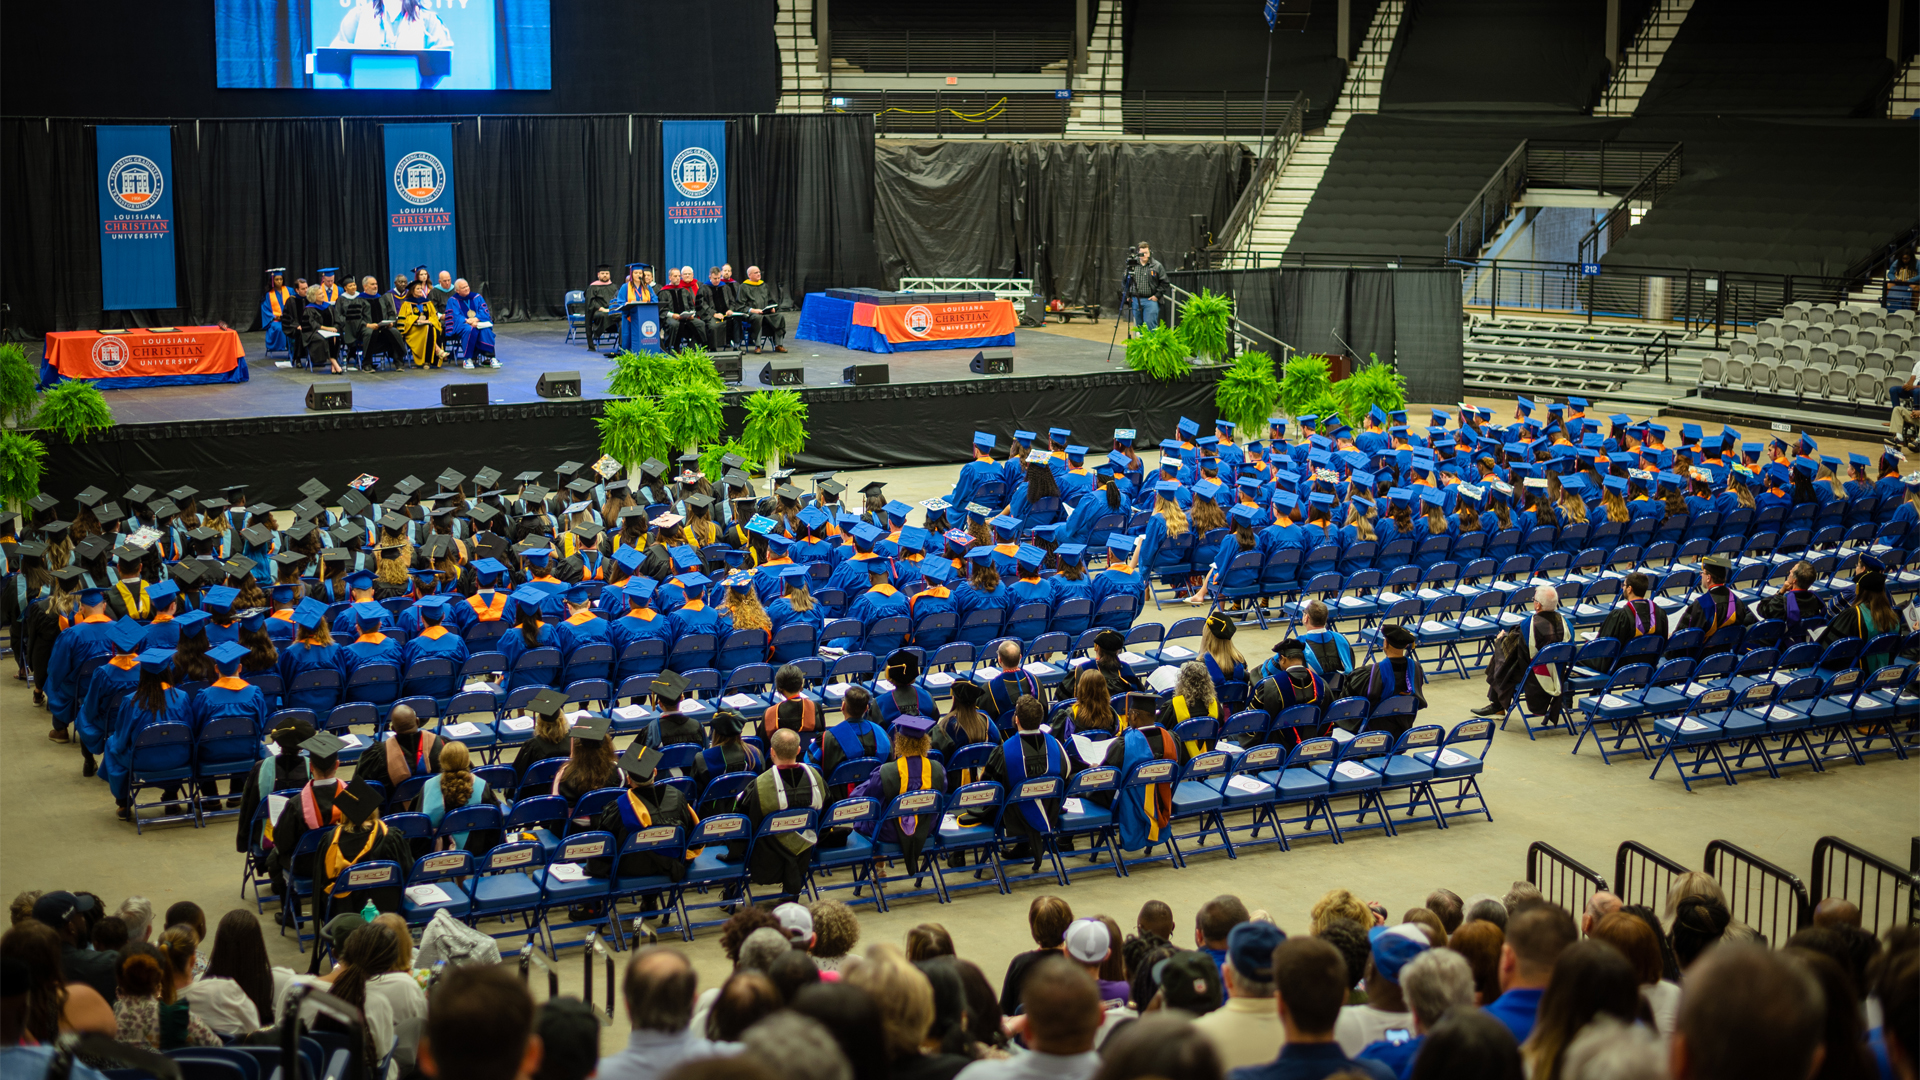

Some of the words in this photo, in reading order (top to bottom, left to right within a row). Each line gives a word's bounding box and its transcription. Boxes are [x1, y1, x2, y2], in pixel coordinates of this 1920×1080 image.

[111, 188, 150, 209] TRANSFORMING
[668, 208, 721, 216] CHRISTIAN
[392, 215, 450, 224] CHRISTIAN
[105, 222, 168, 231] CHRISTIAN
[1585, 265, 1597, 273] 212
[943, 305, 984, 313] LOUISIANA
[935, 313, 989, 323] CHRISTIAN
[941, 323, 985, 332] UNIVERSITY
[132, 346, 203, 357] CHRISTIAN
[140, 358, 200, 366] UNIVERSITY
